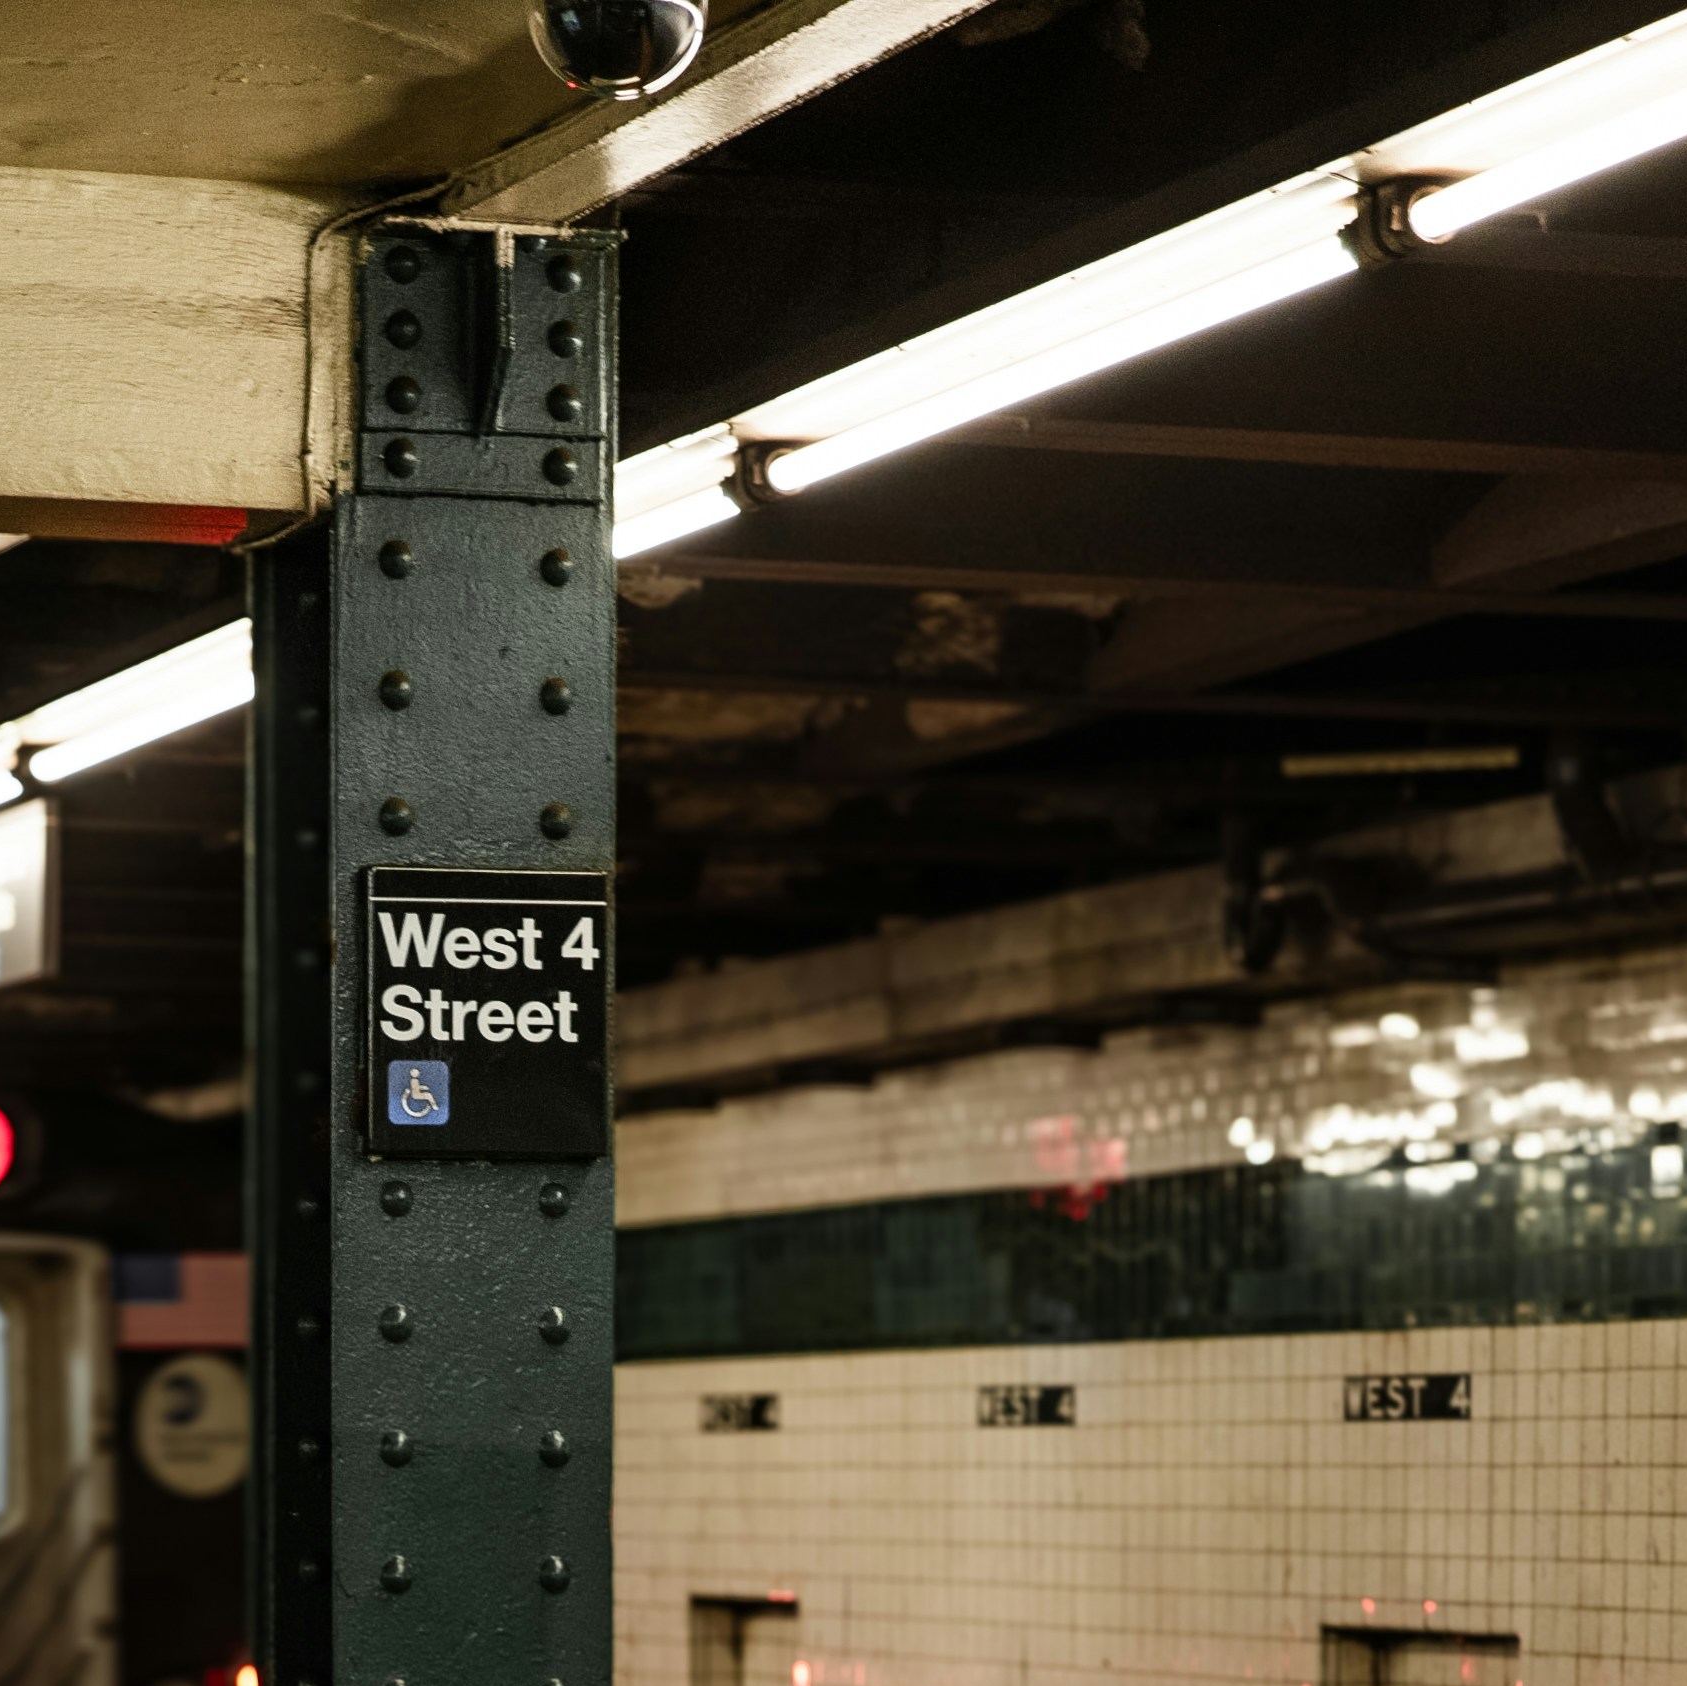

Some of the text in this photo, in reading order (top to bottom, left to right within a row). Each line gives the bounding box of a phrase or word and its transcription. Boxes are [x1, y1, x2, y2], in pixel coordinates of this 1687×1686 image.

[377, 911, 601, 970] West 4
[380, 984, 580, 1043] Street
[1449, 1375, 1470, 1417] 4
